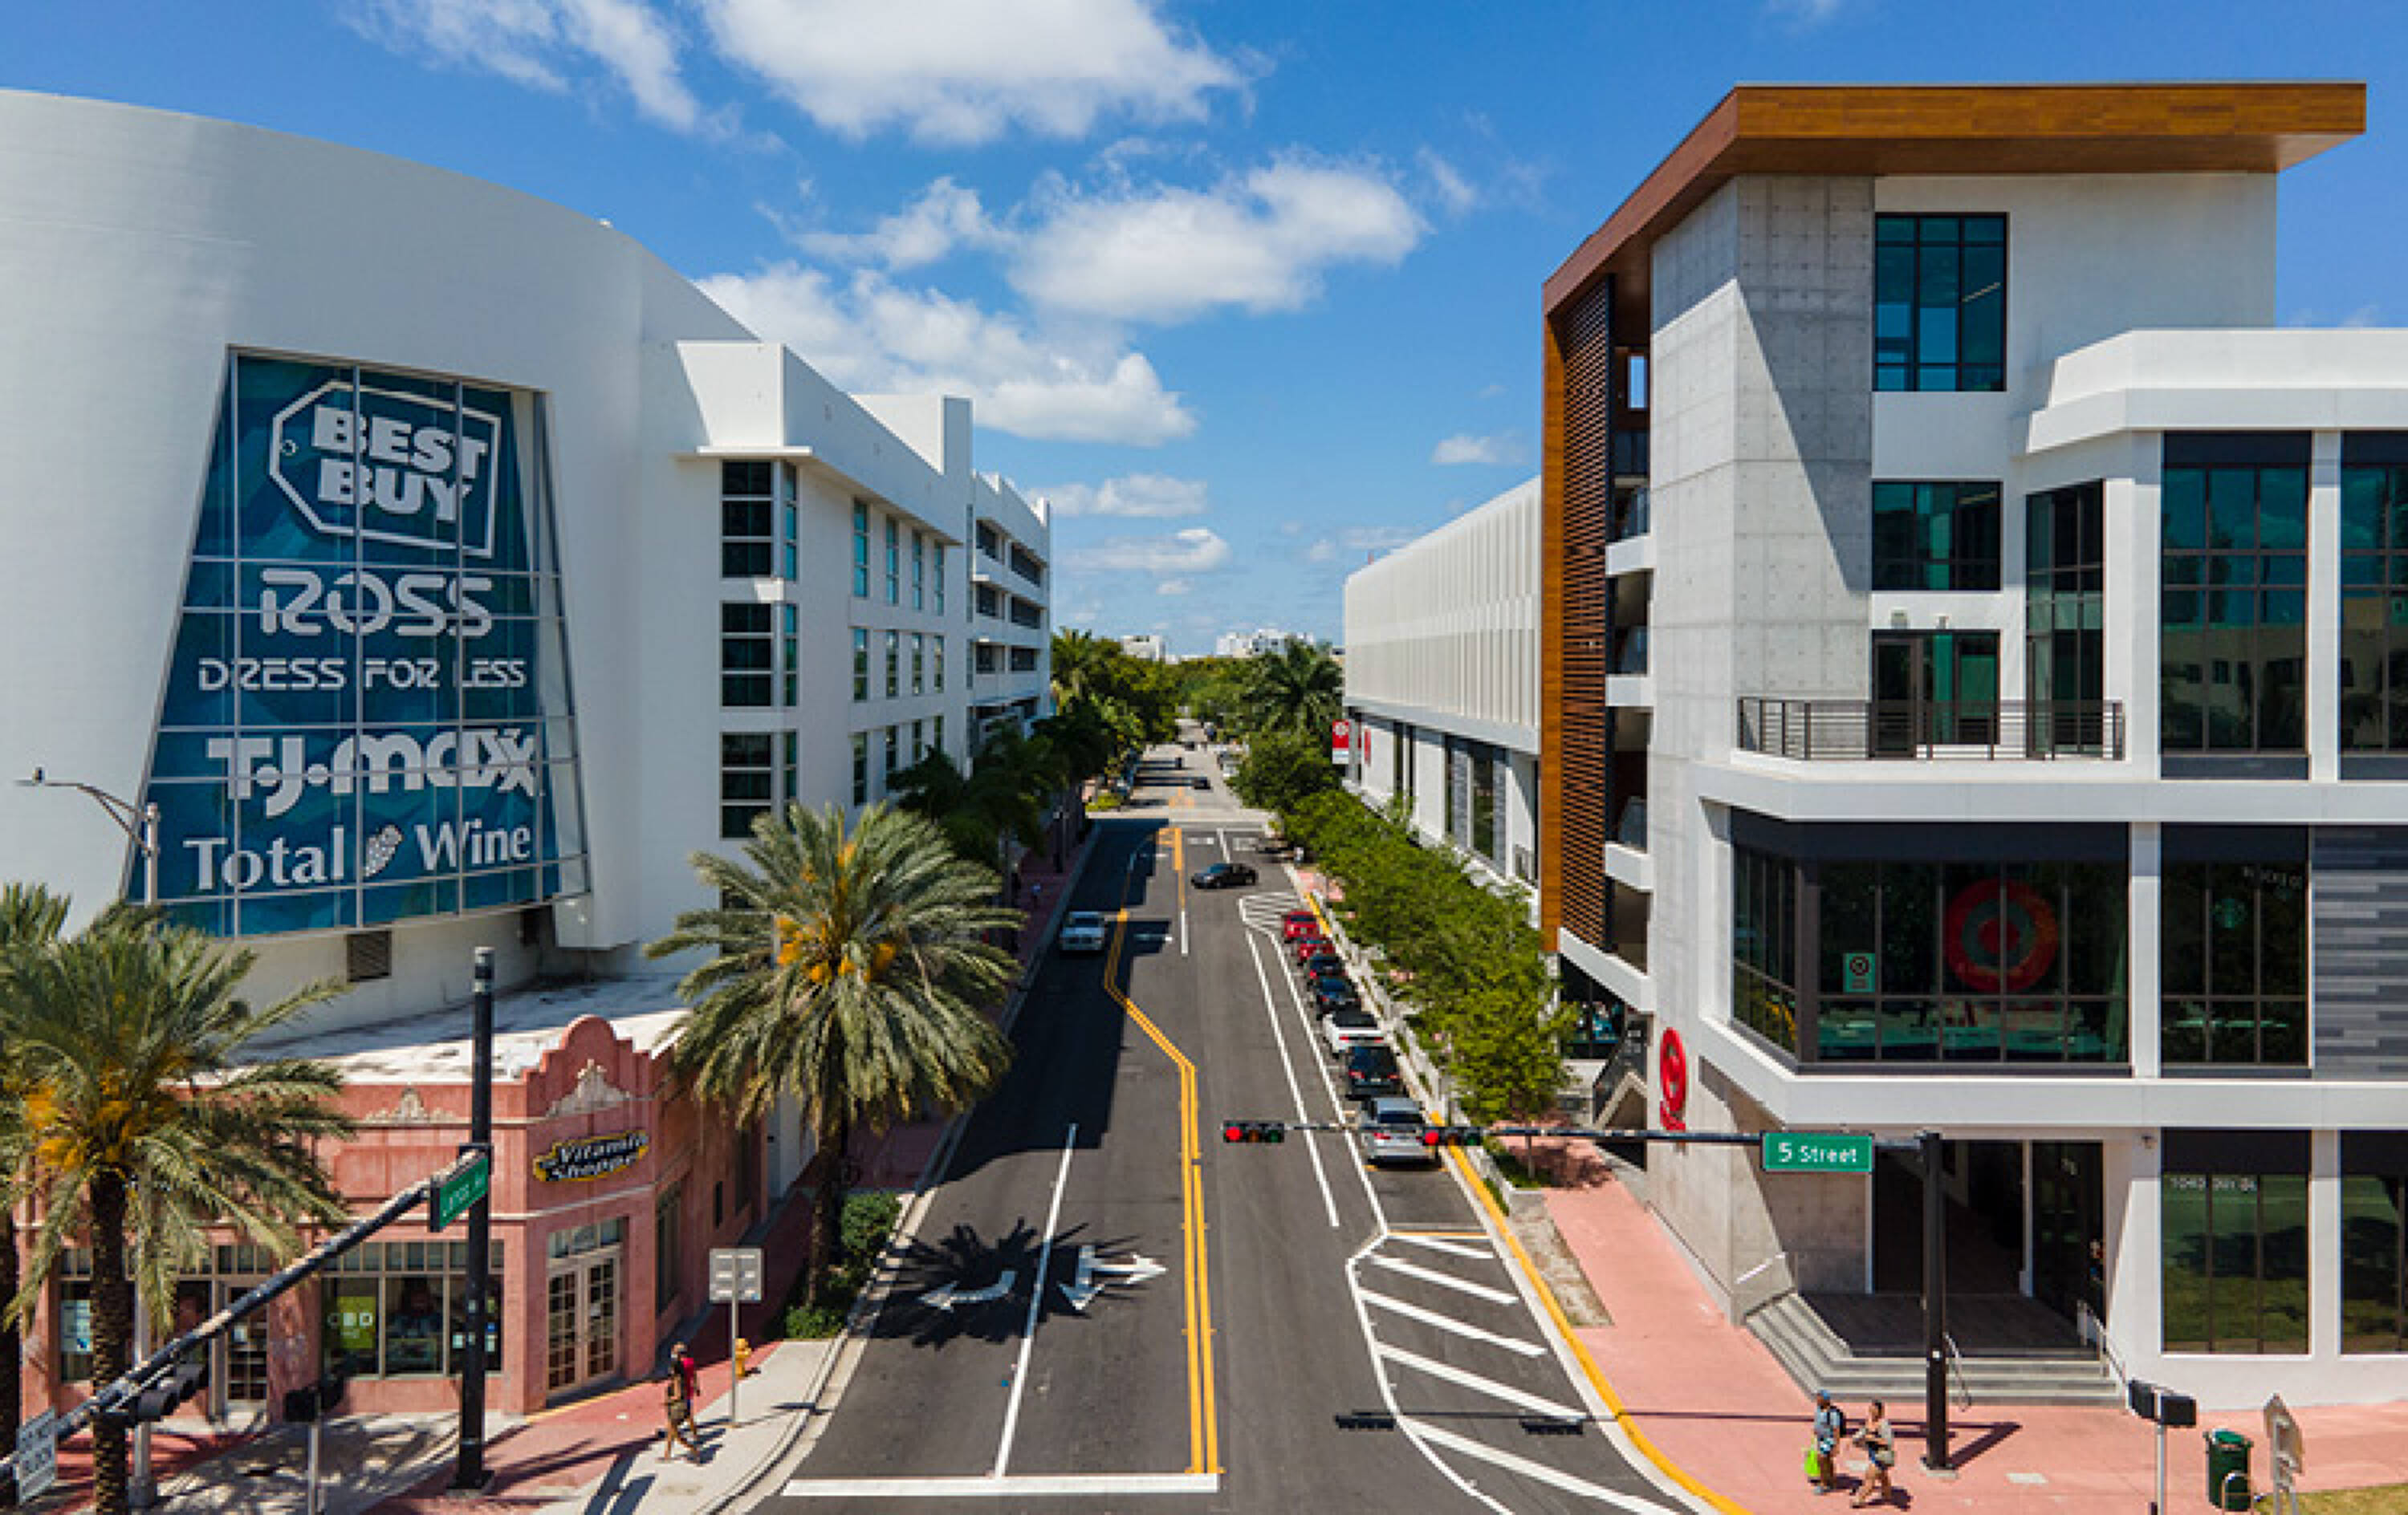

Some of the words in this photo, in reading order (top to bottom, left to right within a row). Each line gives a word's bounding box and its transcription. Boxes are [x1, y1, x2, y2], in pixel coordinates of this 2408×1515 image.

[311, 404, 488, 479] BEST
[319, 458, 472, 522] BUY
[259, 567, 493, 637] ROSS
[198, 658, 347, 691] DRESS
[365, 660, 440, 689] FOR
[453, 660, 527, 689] LESS
[182, 824, 344, 891] Total
[413, 818, 531, 871] Wine
[1778, 1142, 1792, 1164] 5
[1800, 1145, 1857, 1164] Street
